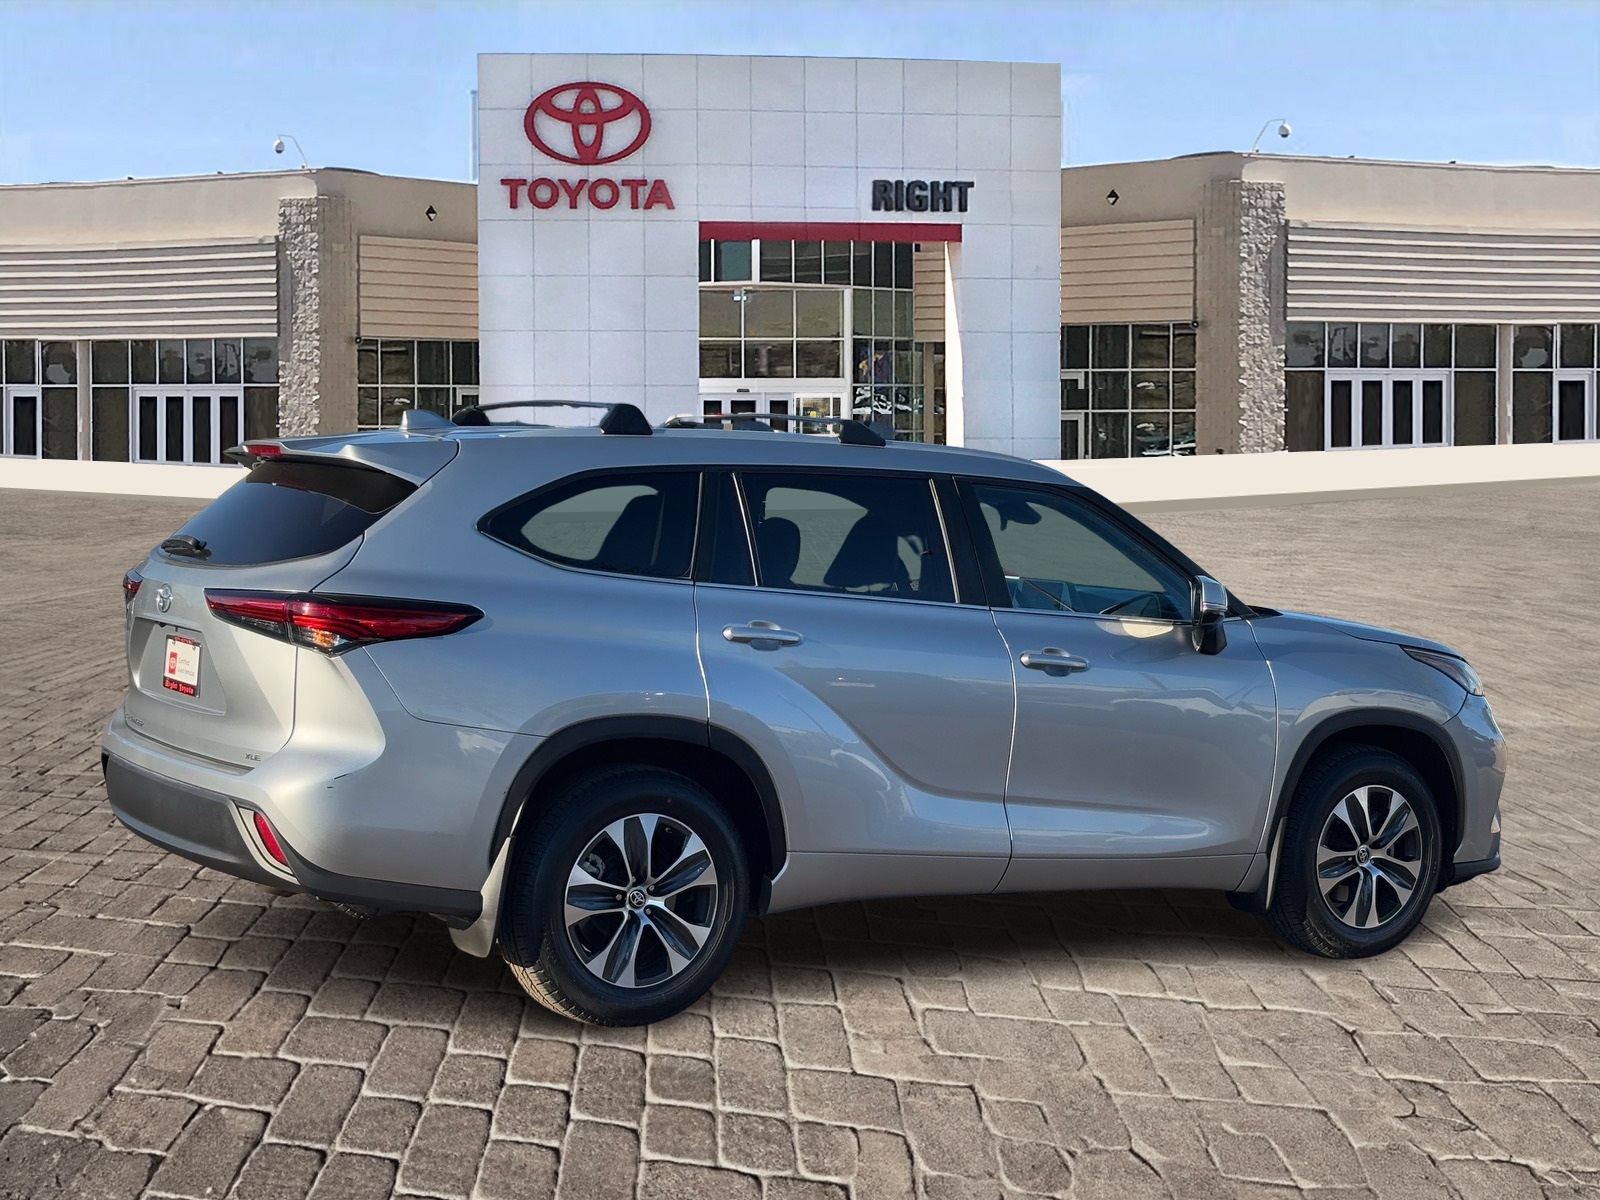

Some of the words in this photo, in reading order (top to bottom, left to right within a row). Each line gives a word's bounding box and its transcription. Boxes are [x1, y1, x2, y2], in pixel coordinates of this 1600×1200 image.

[500, 178, 675, 210] TOYOTA
[871, 179, 975, 212] RIGHT
[245, 752, 261, 762] XLE
